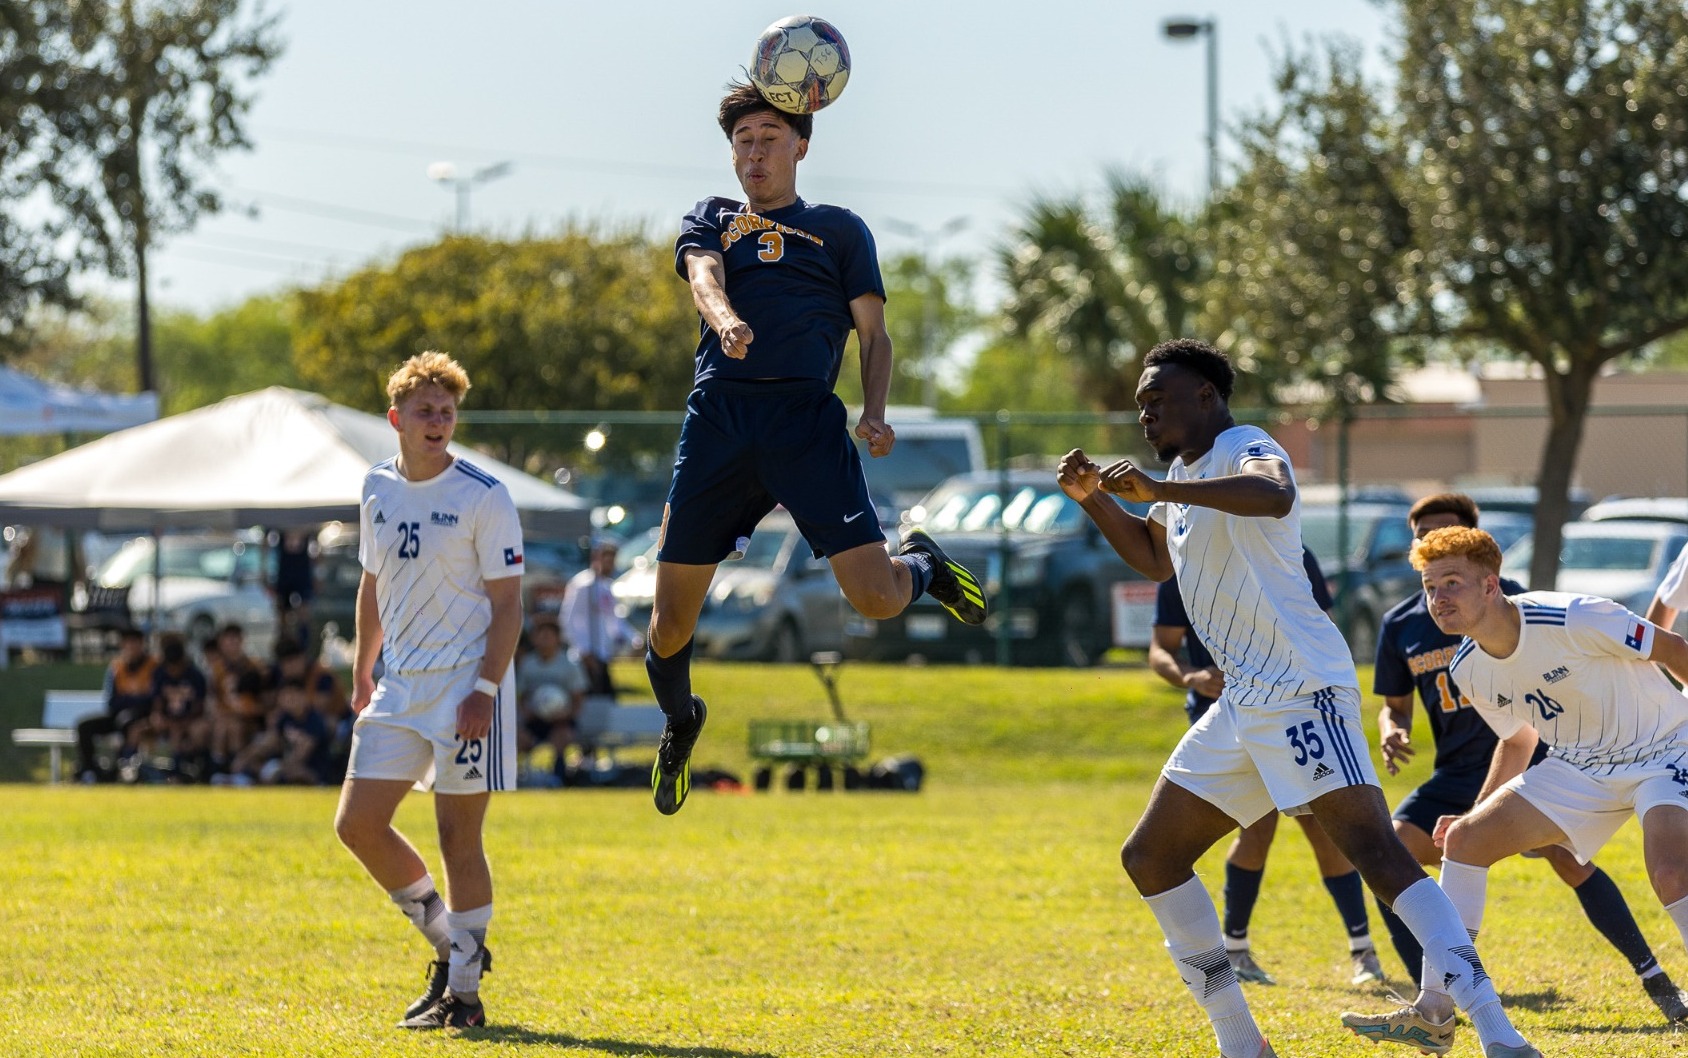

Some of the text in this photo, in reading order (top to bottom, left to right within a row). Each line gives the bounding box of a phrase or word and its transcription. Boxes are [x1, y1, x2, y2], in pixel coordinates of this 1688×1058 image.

[762, 91, 794, 103] LECT
[757, 231, 784, 262] 3
[397, 521, 420, 559] 25
[1542, 665, 1570, 682] BLINN
[1435, 671, 1472, 713] 1
[1525, 688, 1564, 721] 26
[454, 733, 482, 764] 25
[1285, 720, 1325, 766] 35
